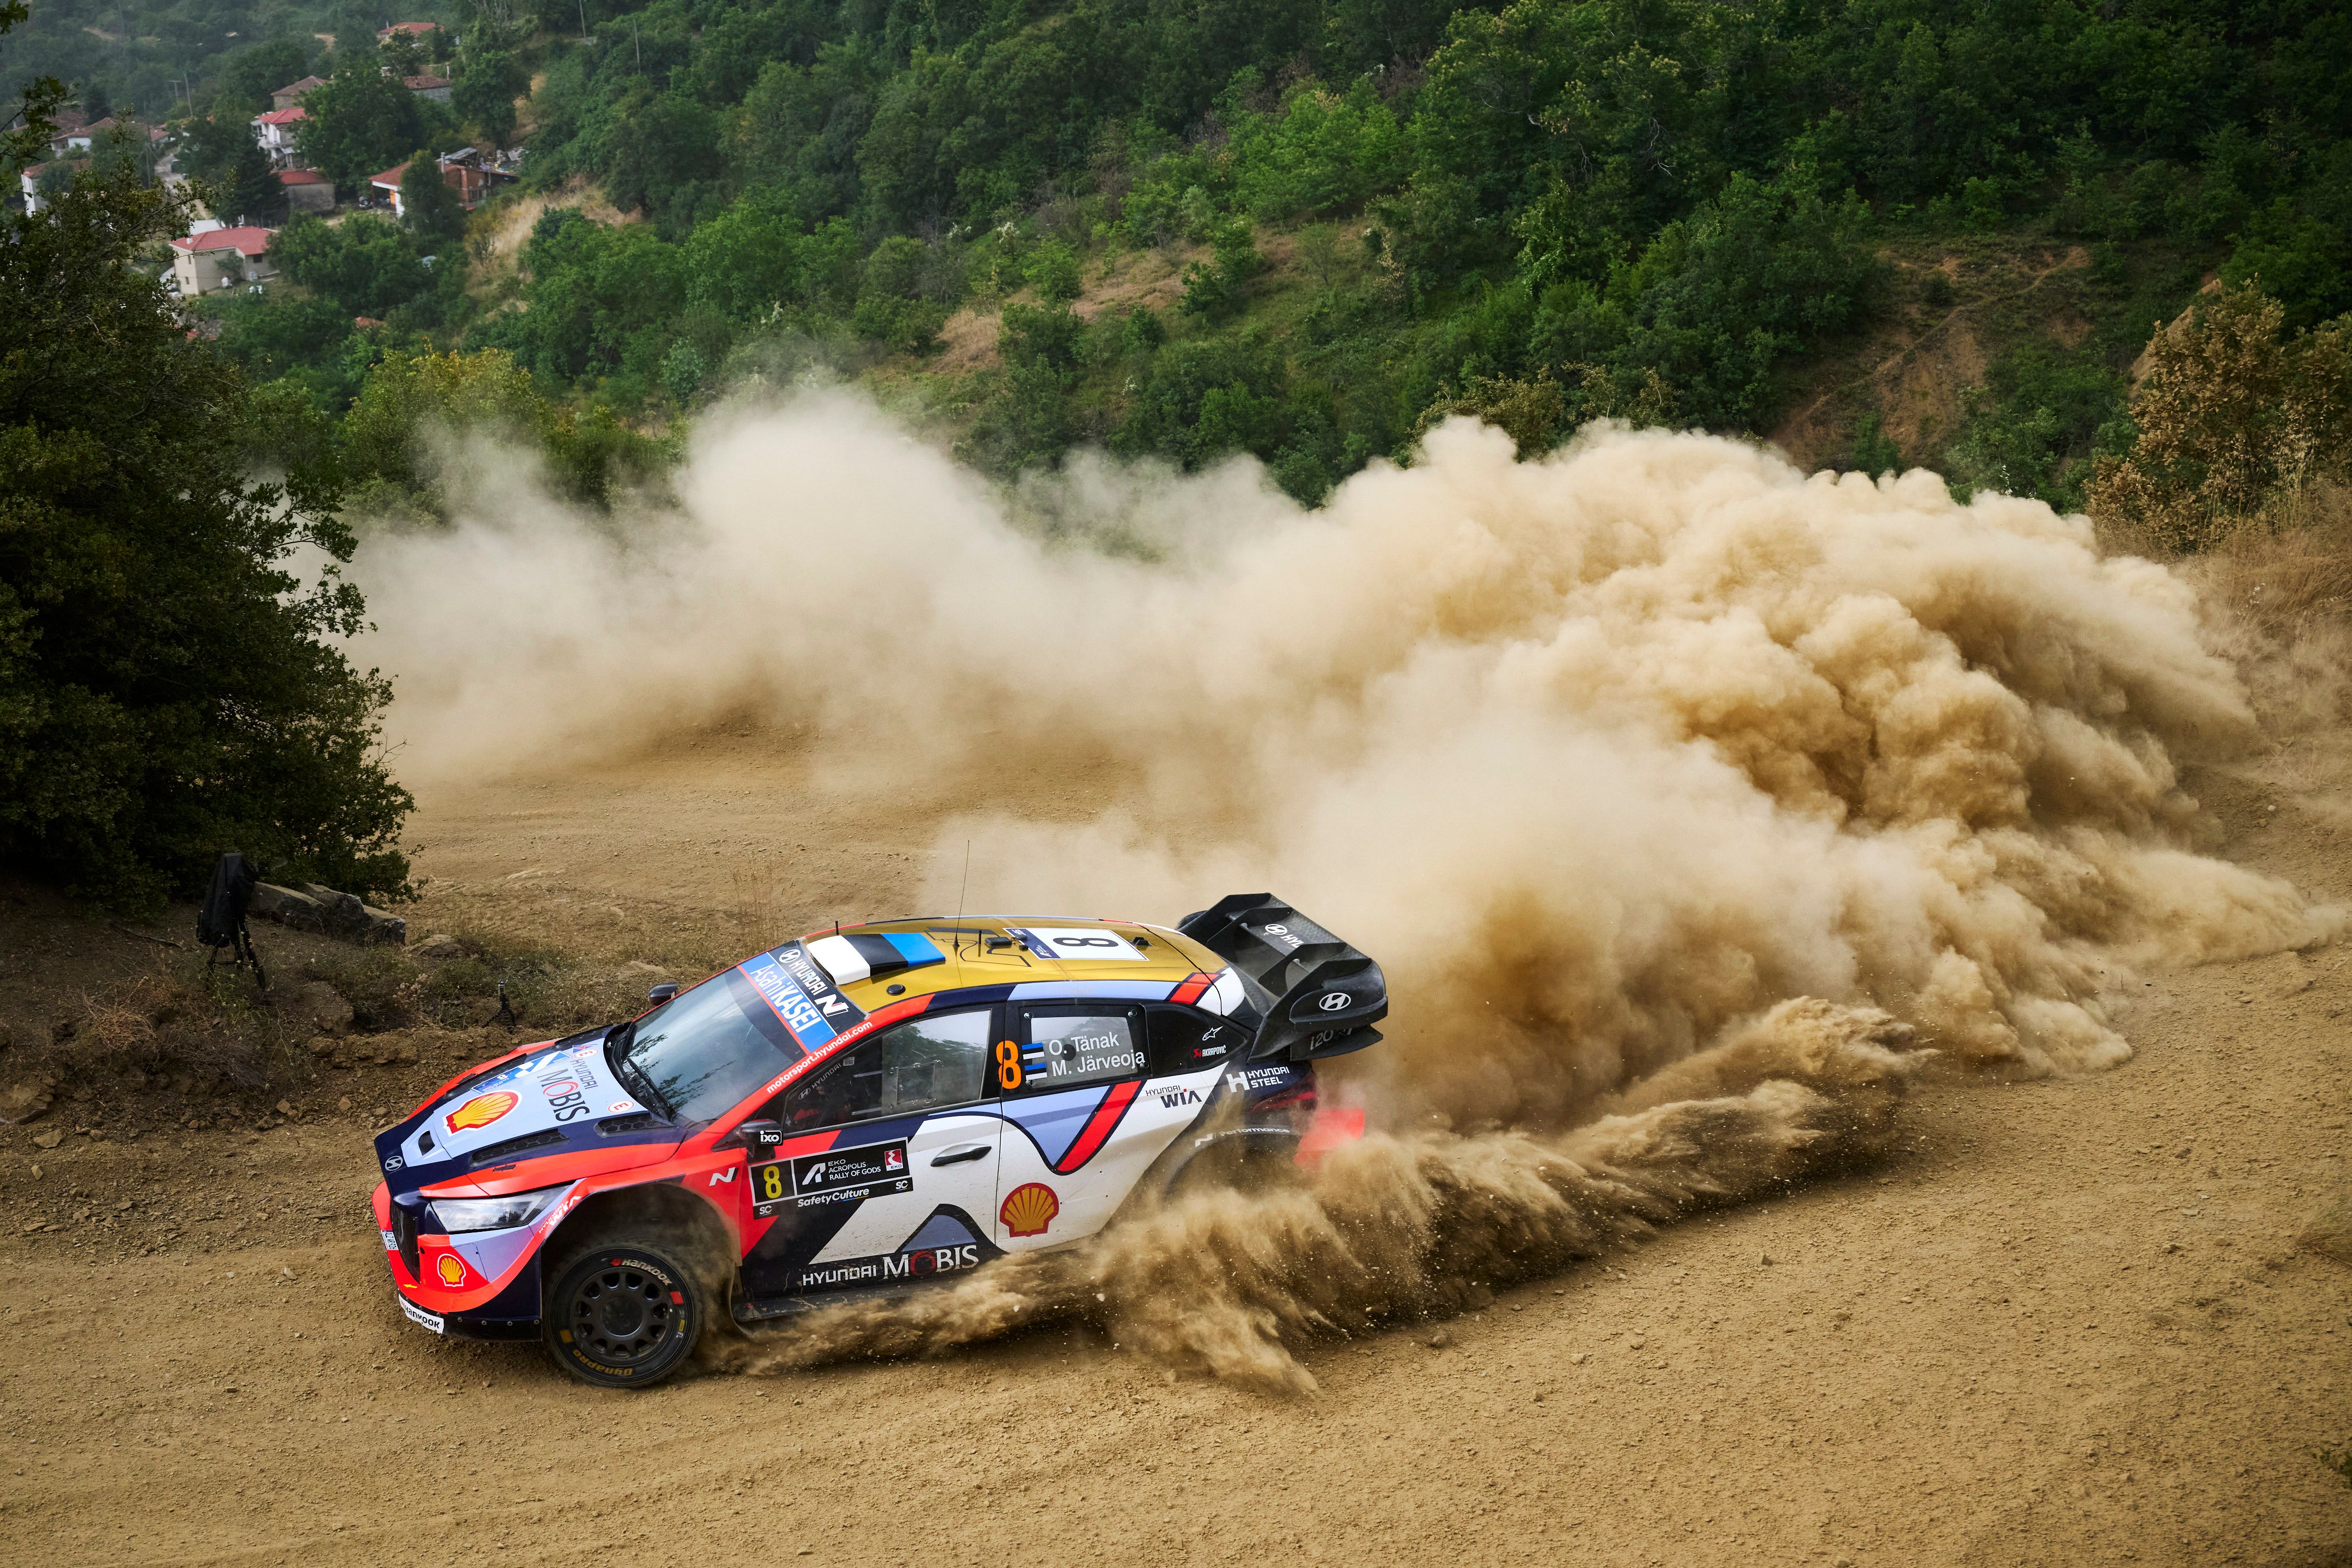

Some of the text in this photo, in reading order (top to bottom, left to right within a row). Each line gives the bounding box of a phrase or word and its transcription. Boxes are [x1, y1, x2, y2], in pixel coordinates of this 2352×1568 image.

[1053, 937, 1119, 947] 8
[789, 959, 849, 1018] HYUNDAI N
[1049, 1031, 1120, 1056] O. Tänak
[1310, 1030, 1334, 1051] i20
[766, 1021, 873, 1093] motorsport.hyundai.com
[996, 1040, 1021, 1089] 8
[1052, 1049, 1145, 1077] M. Järveoja
[570, 1058, 598, 1089] HYUNDAI
[812, 1063, 841, 1089] HYUNDAI
[1247, 1066, 1290, 1079] HYUNDAI
[1250, 1076, 1283, 1089] STEEL
[537, 1068, 590, 1122] MOBIS
[1146, 1085, 1181, 1097] HYUNDAI
[760, 1130, 779, 1142] ixo
[1219, 1128, 1290, 1137] Performance
[828, 1162, 866, 1173] ACROPOLIS
[829, 1171, 849, 1181] RALLY
[861, 1166, 881, 1175] GODS
[763, 1166, 782, 1199] 8
[895, 1180, 908, 1190] SC
[797, 1187, 870, 1207] SafetyCulture
[539, 1203, 564, 1233] HYUNDAI
[759, 1205, 772, 1215] SC
[803, 1244, 979, 1286] HYUNDAI MOBIS
